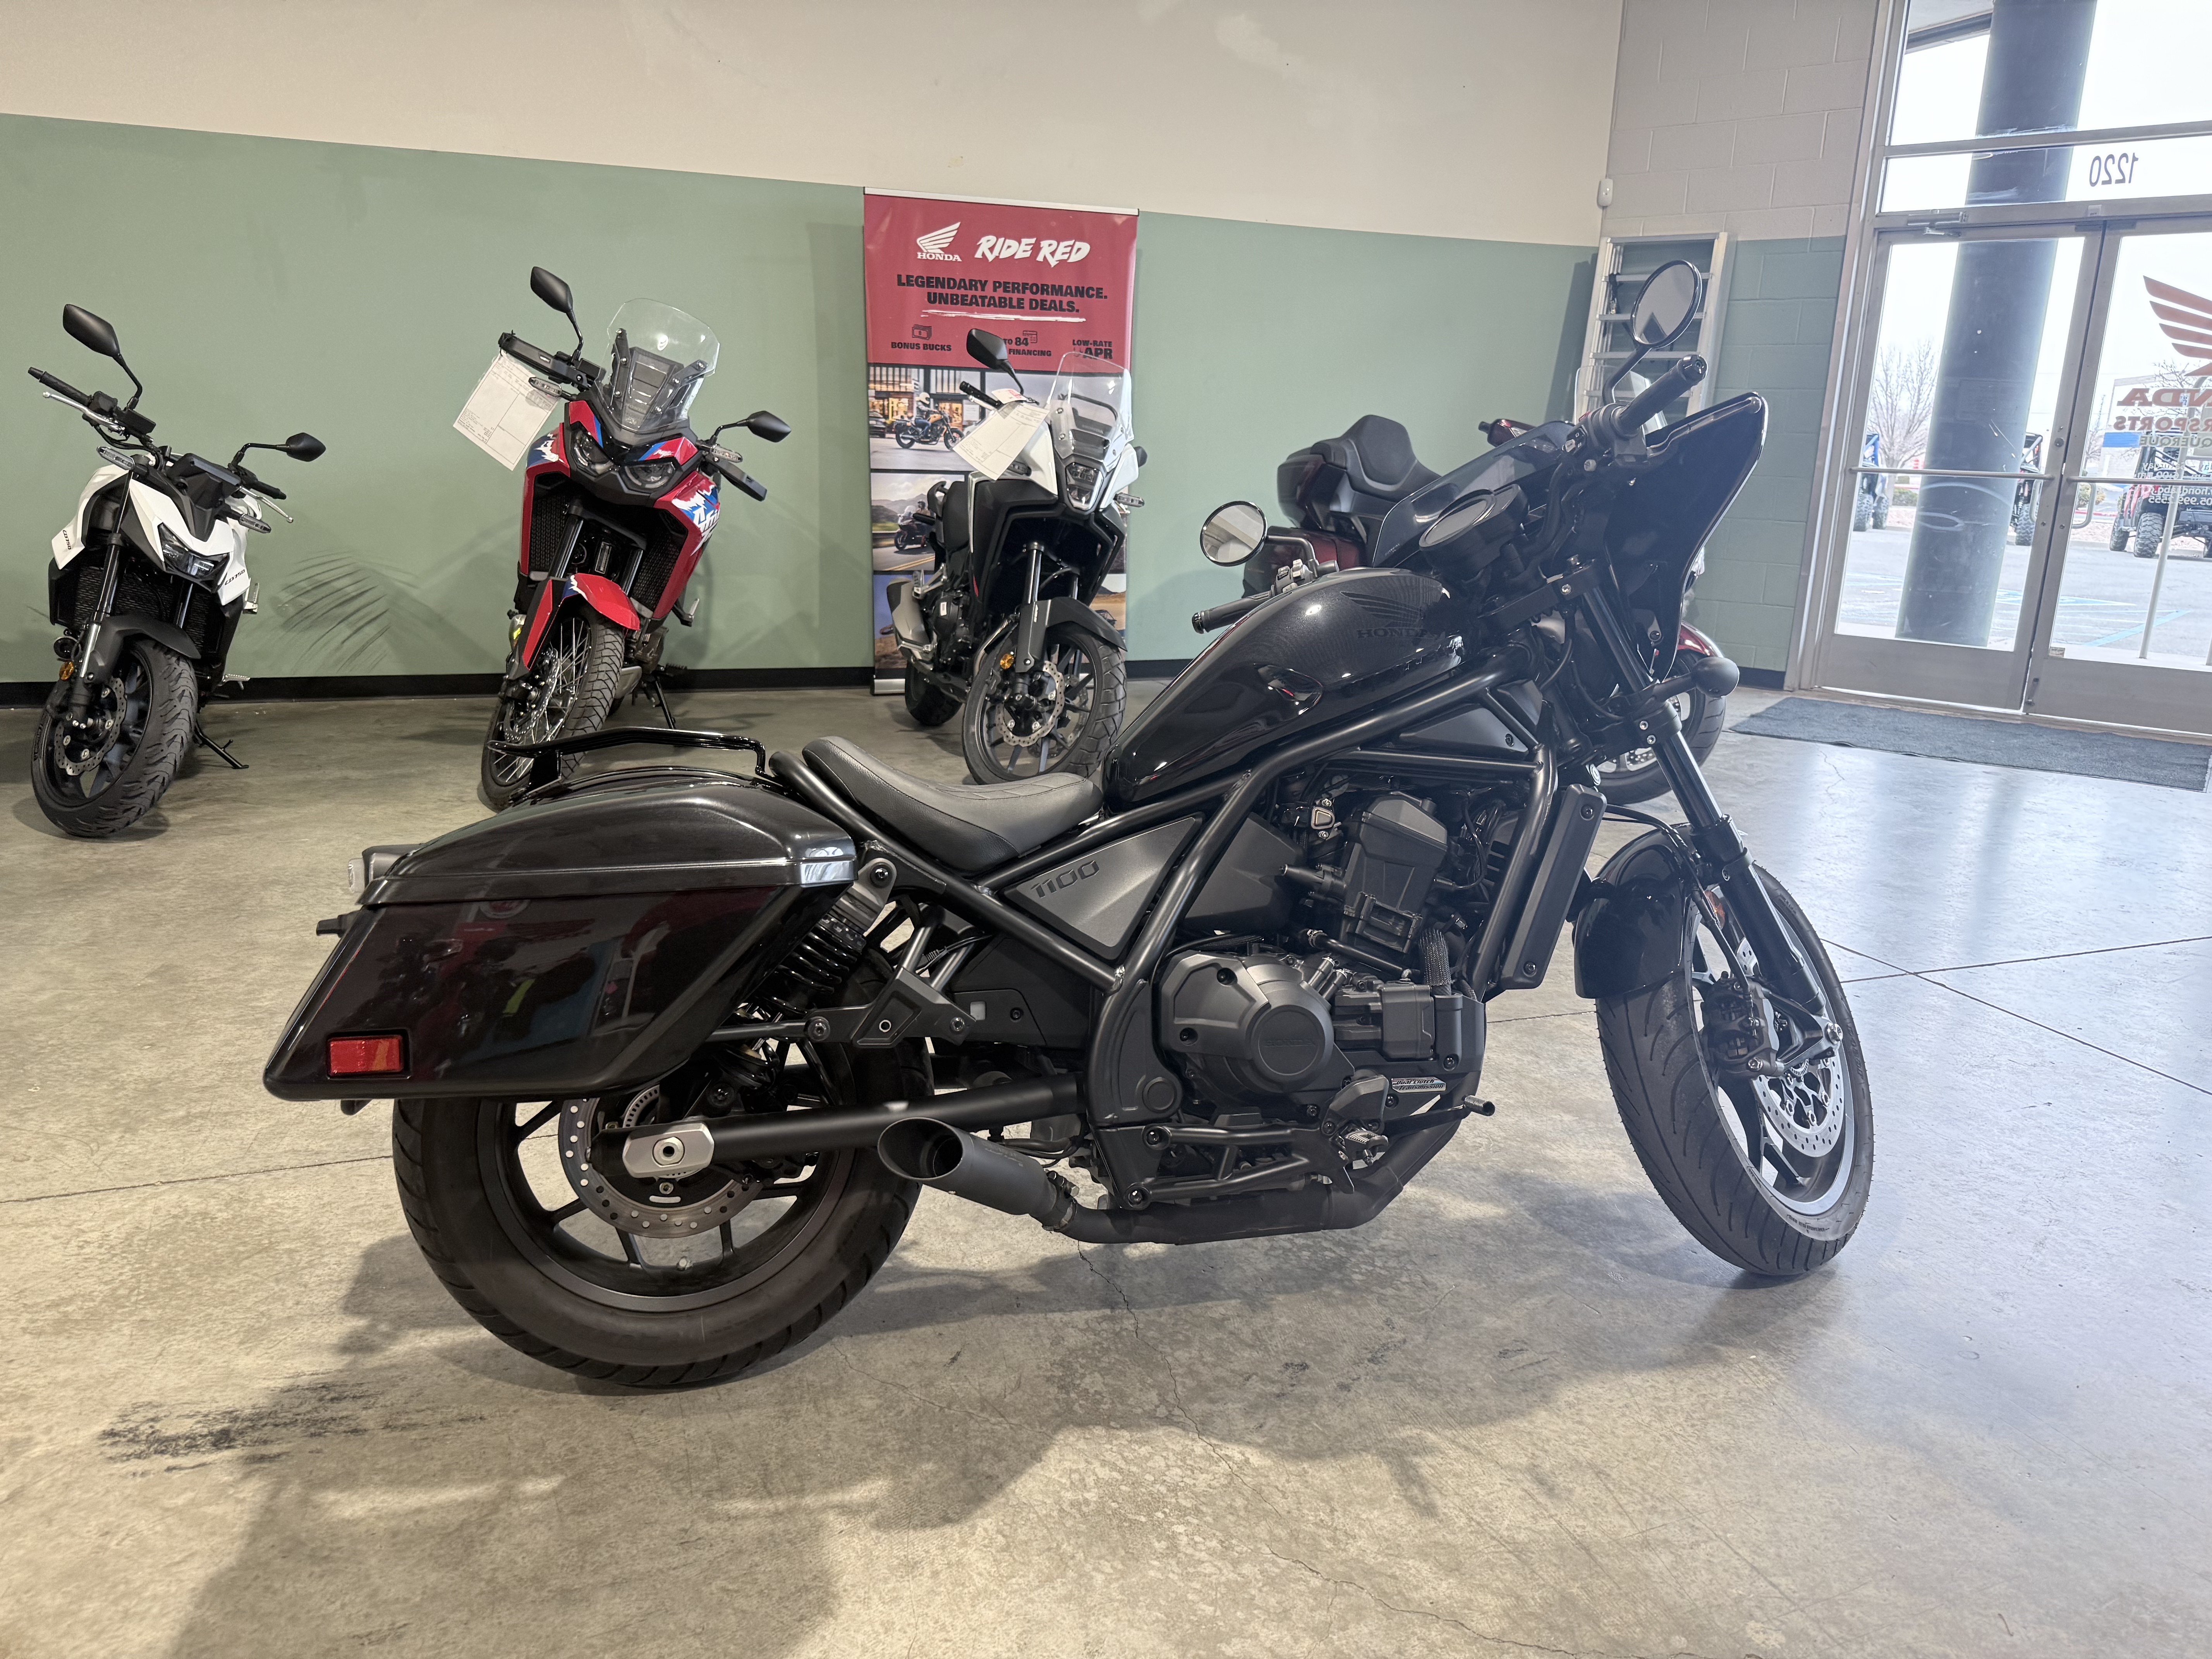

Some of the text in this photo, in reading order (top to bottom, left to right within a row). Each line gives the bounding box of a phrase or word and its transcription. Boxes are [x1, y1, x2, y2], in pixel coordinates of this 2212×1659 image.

[917, 252, 962, 262] HONDA
[974, 235, 1091, 268] RIDE RED
[896, 274, 1108, 299] LEGENDARY PERFORMANCE.
[927, 292, 1080, 313] UNBEATABLE DEALS.
[891, 342, 952, 352] BONUS BUCKS
[1015, 337, 1029, 347] 84
[1072, 339, 1113, 348] LOW-RATE
[1008, 349, 1052, 357] FINANCING
[1083, 347, 1113, 359] APR
[63, 530, 72, 550] CB750
[225, 569, 245, 586] CB750
[1030, 860, 1100, 898] 1100
